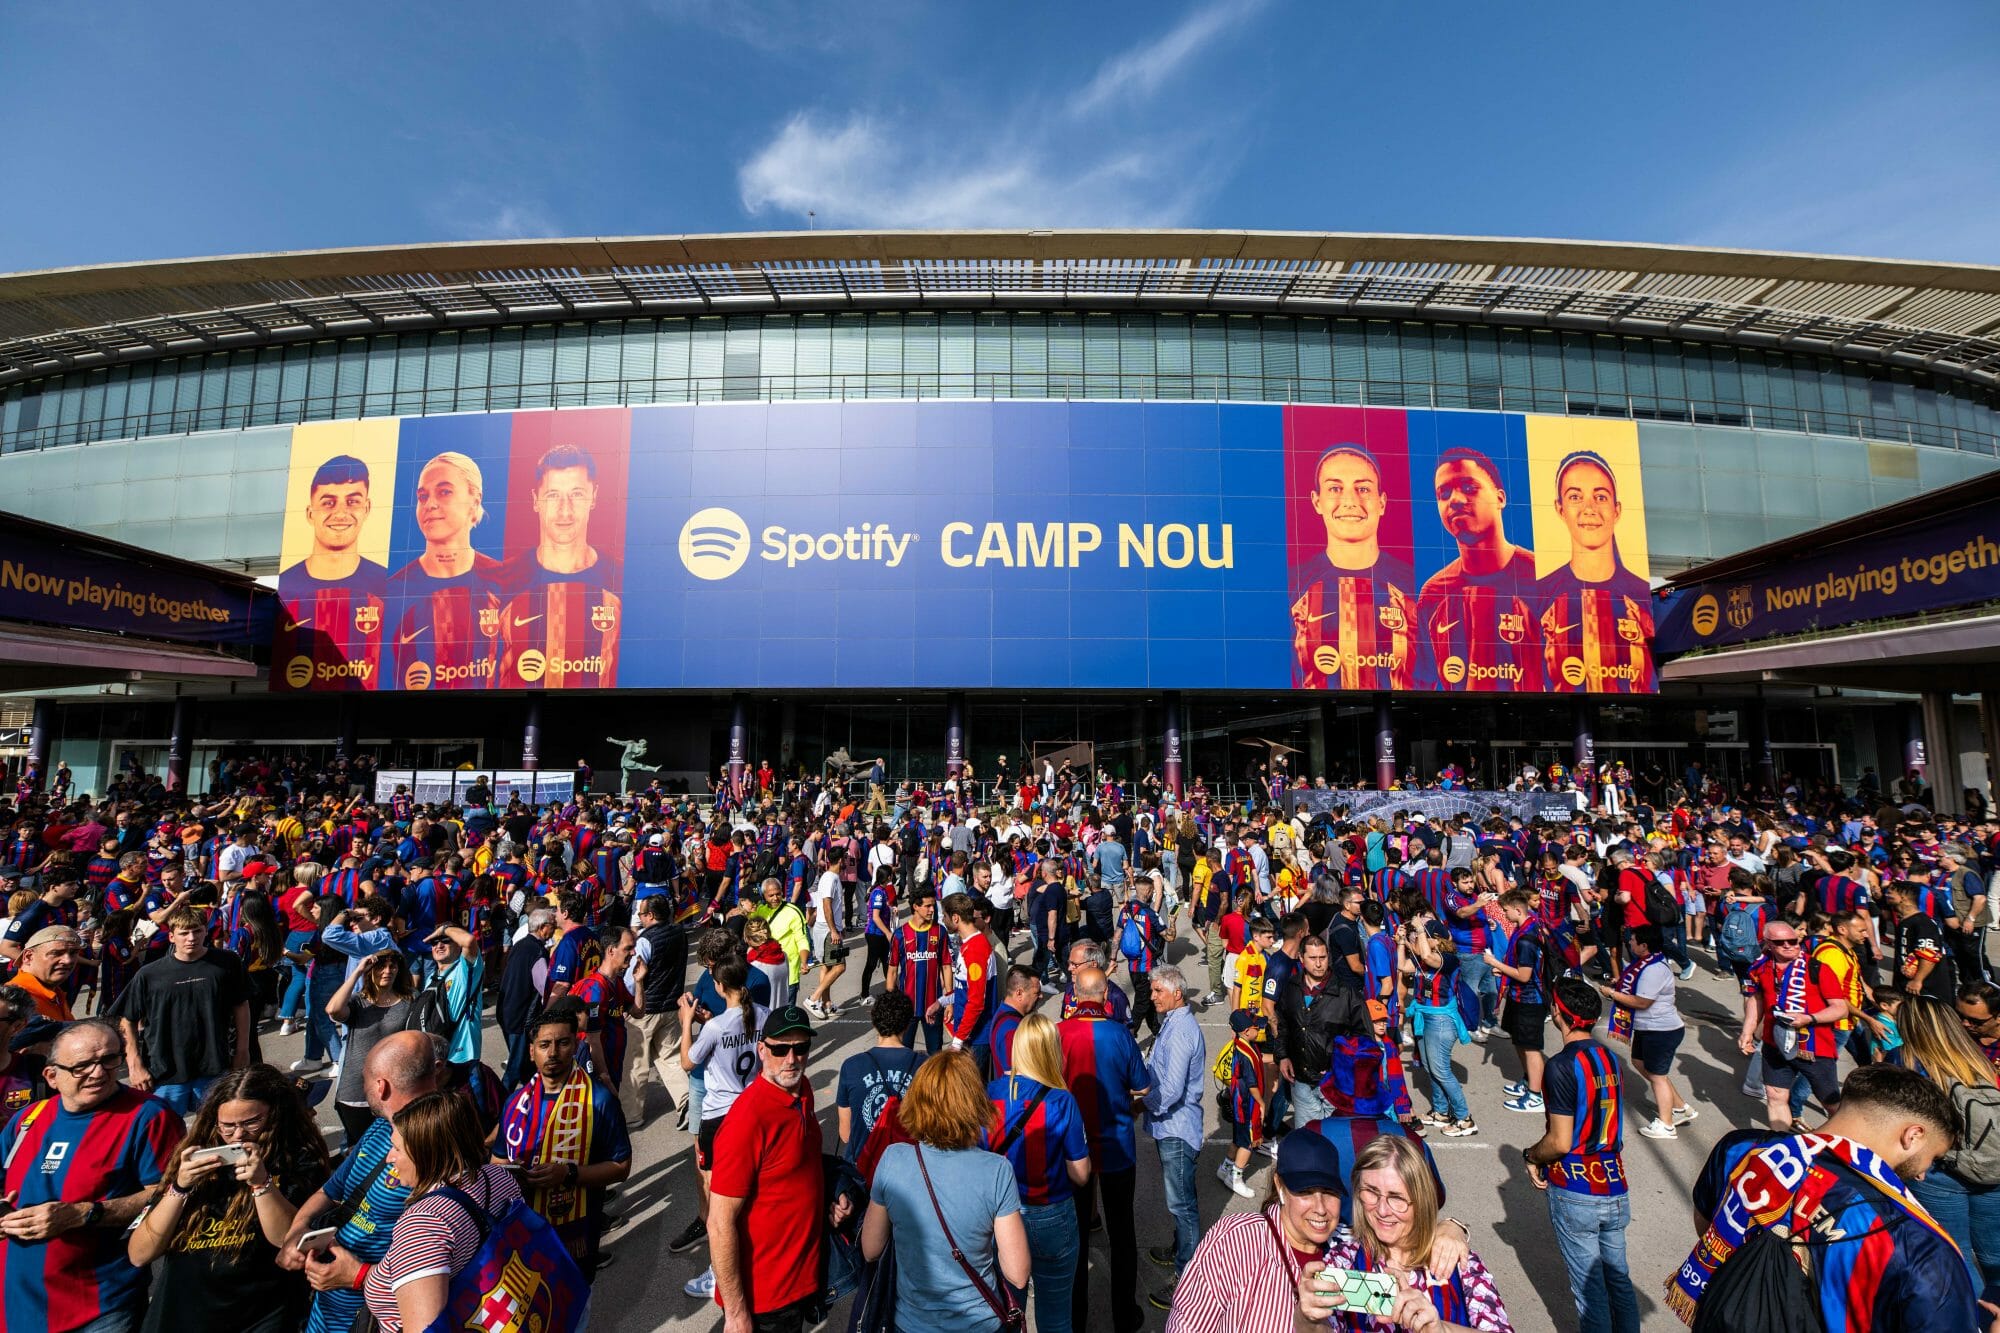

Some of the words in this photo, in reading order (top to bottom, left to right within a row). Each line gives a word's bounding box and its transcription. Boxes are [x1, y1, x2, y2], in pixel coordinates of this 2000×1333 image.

[941, 522, 1102, 568] CAMP
[1118, 523, 1234, 569] NOU
[1766, 585, 1812, 612] Now
[1815, 564, 1897, 608] playing
[1900, 535, 2000, 585] togeth
[1, 560, 64, 597] Now
[67, 576, 146, 617] playing
[149, 591, 231, 623] together
[317, 659, 373, 681] Spotify
[435, 657, 497, 683] Spotify
[550, 655, 607, 675] Spotify
[1344, 652, 1402, 671] Spotify
[1468, 663, 1524, 683] Spotify
[1589, 663, 1640, 684] Spotify
[906, 951, 937, 961] Rakuten
[736, 1051, 755, 1089] 9
[1600, 1099, 1616, 1145] 7
